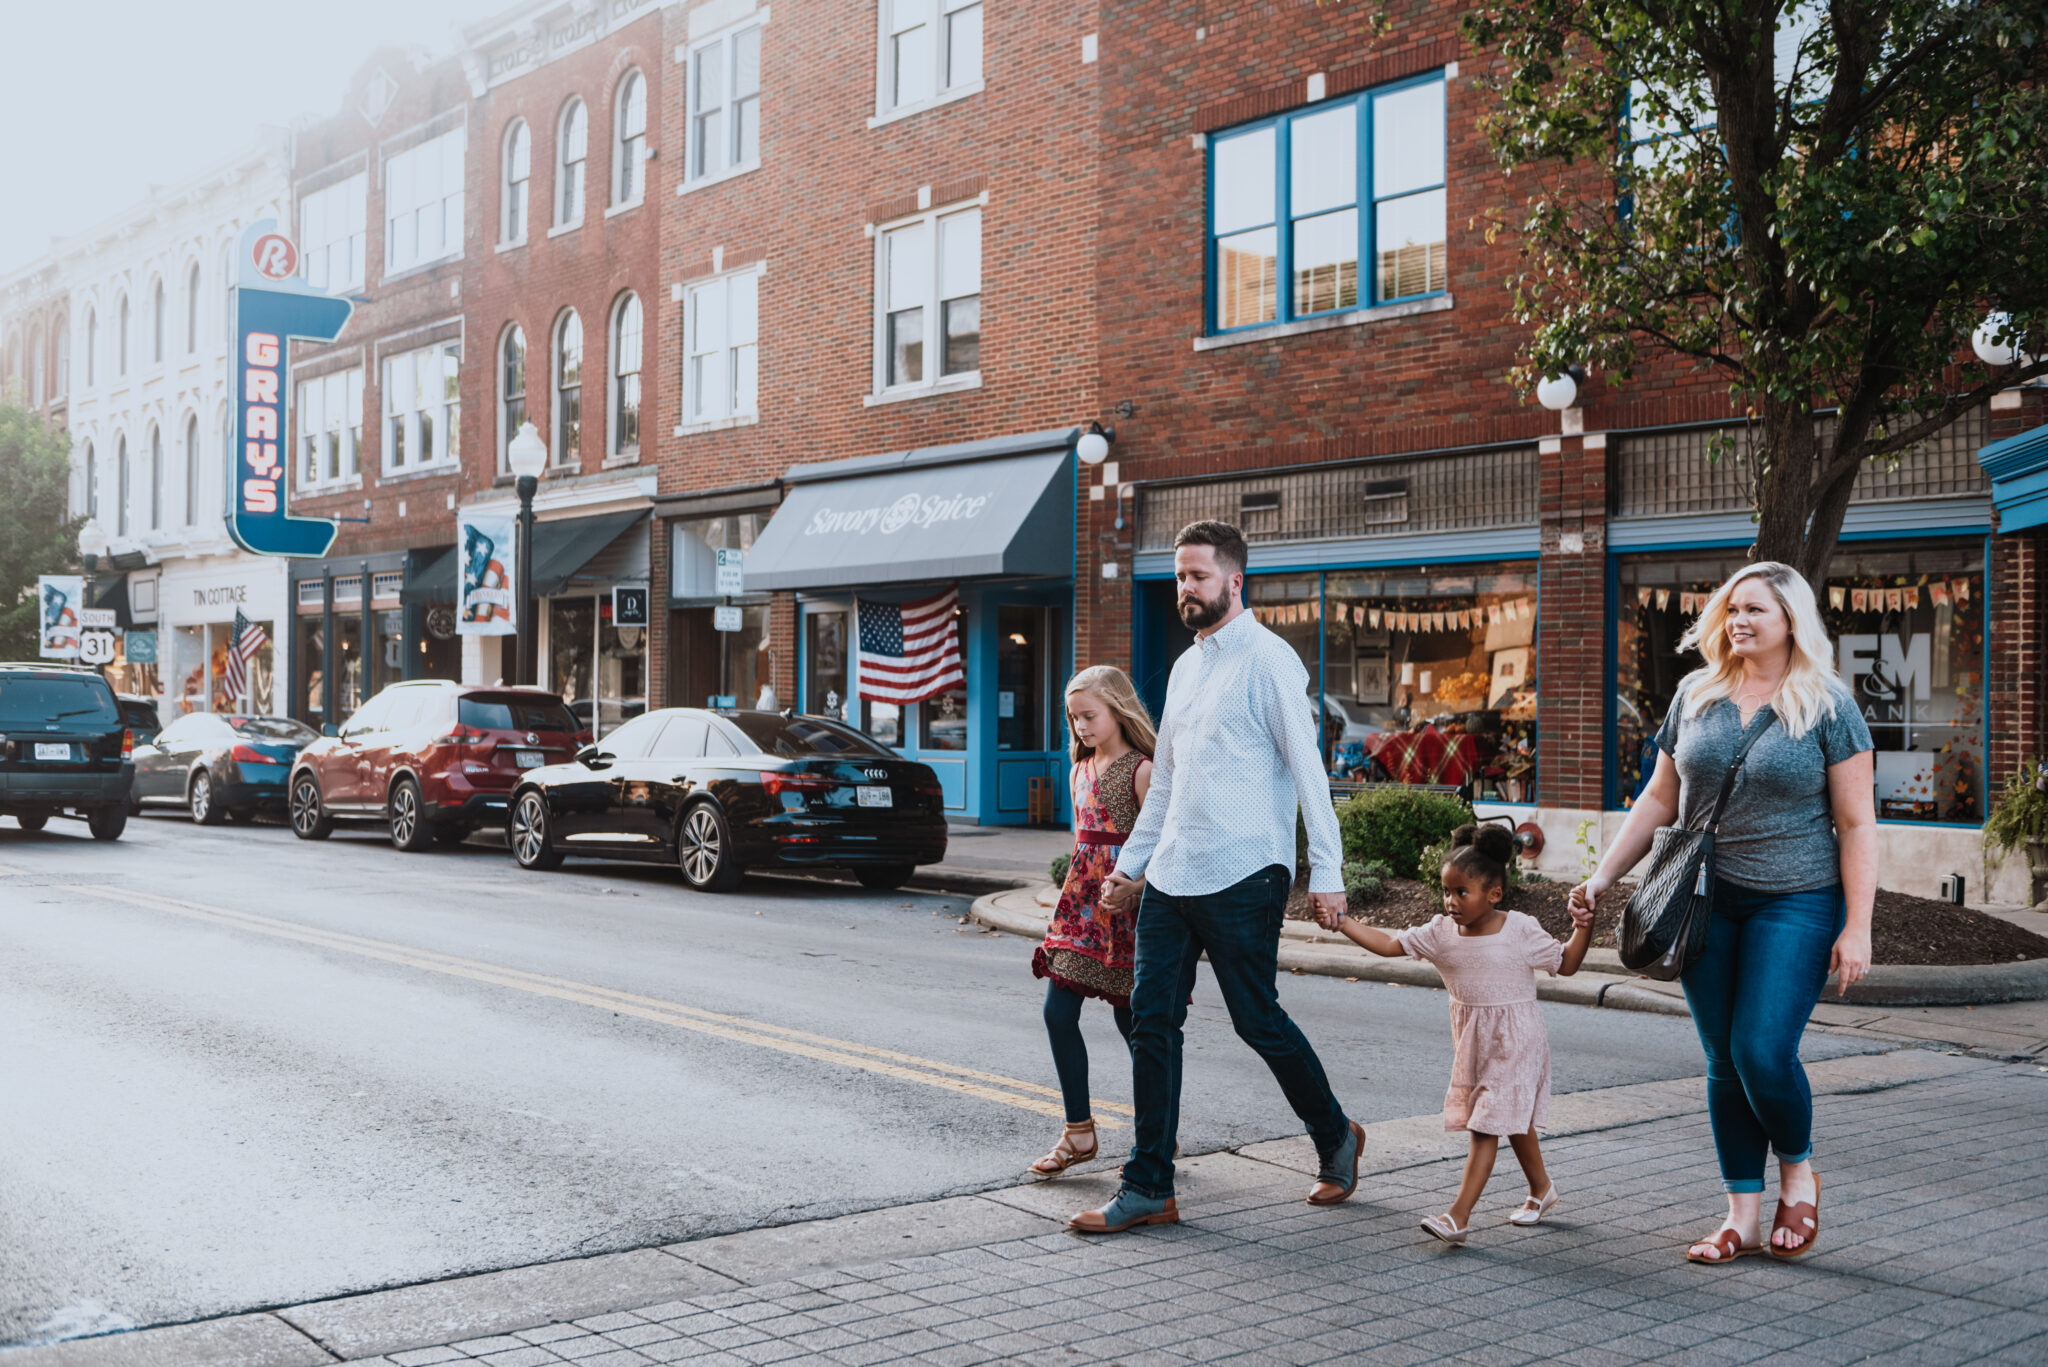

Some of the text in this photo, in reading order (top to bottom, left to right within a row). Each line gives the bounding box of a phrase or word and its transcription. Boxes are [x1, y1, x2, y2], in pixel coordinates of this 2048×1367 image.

[244, 332, 283, 513] GRAY'S
[804, 492, 987, 536] Savory Spice
[718, 551, 726, 565] 2
[193, 584, 247, 607] TIN COTTAGE
[82, 612, 113, 622] SOUTH
[87, 638, 107, 656] 31
[1839, 633, 1931, 701] F&M
[1863, 704, 1929, 721] ANK
